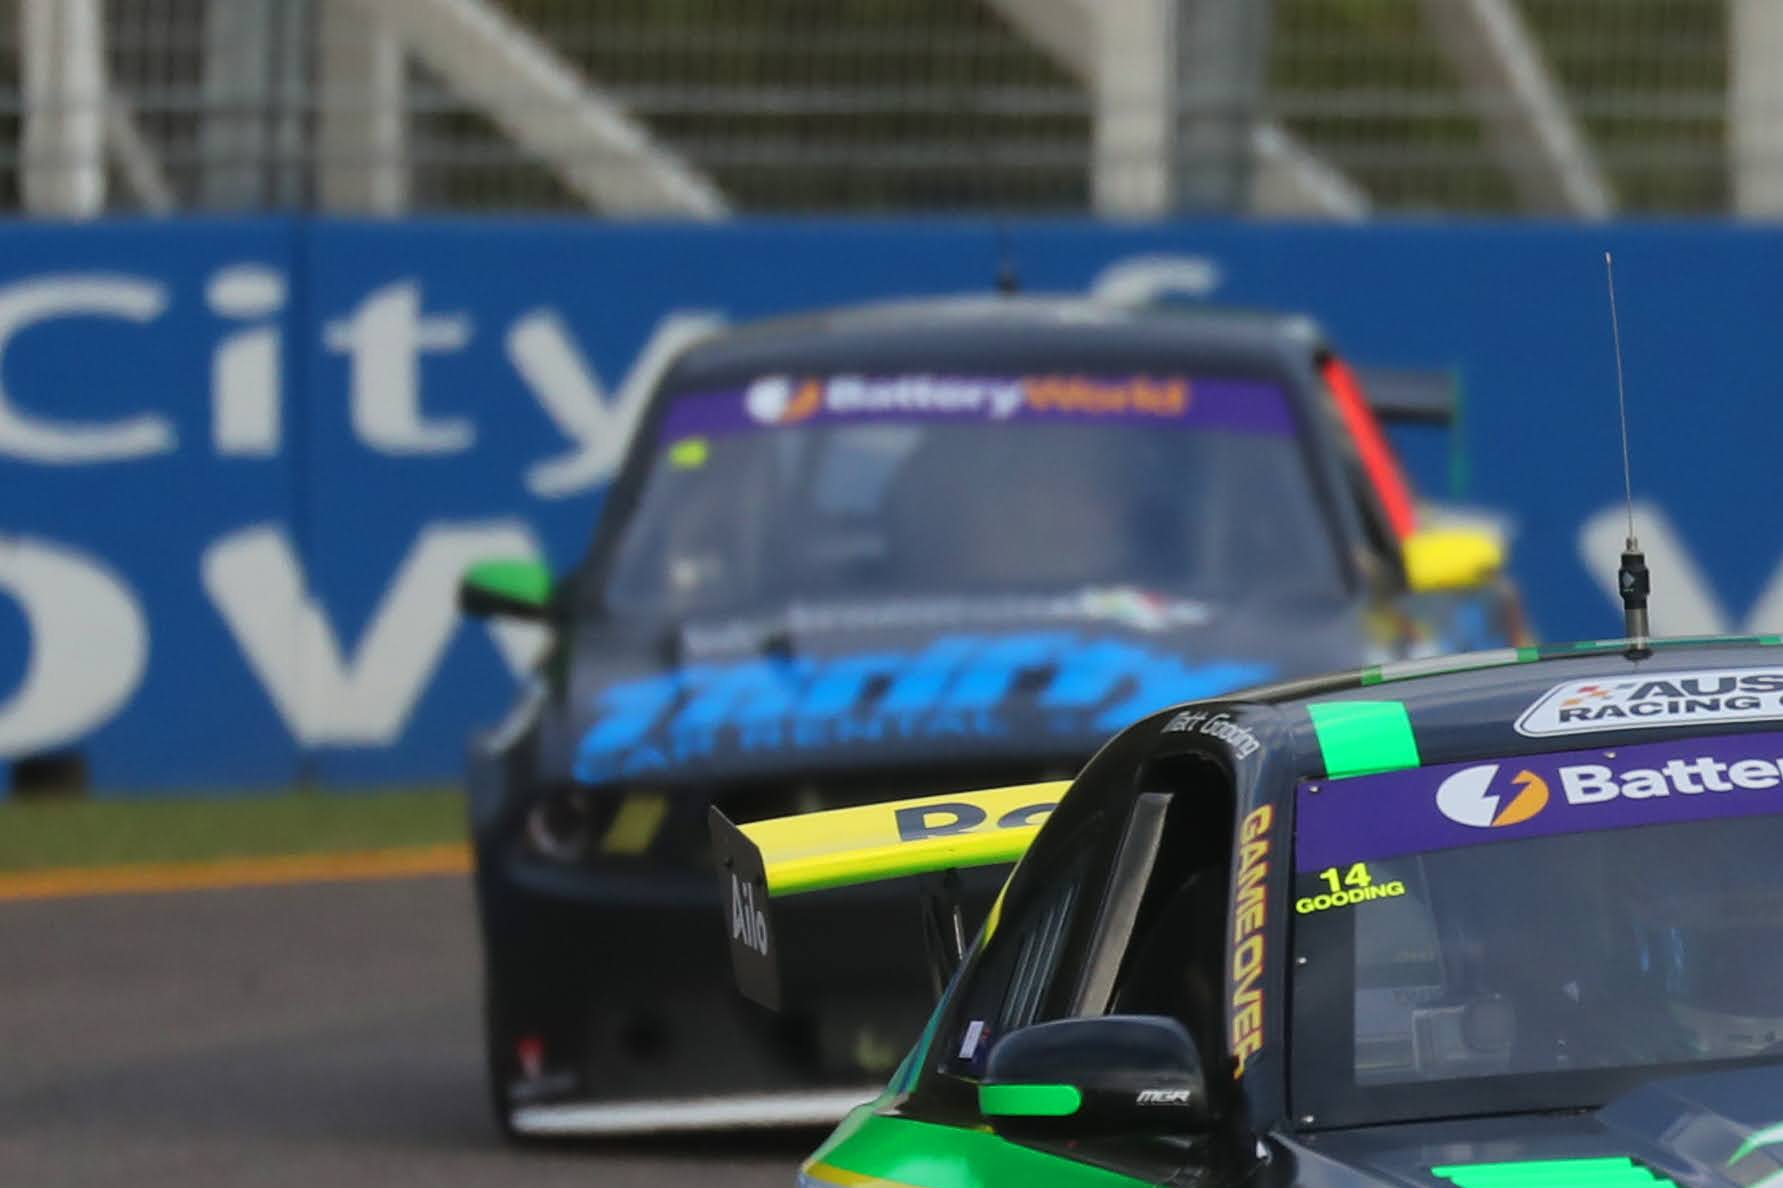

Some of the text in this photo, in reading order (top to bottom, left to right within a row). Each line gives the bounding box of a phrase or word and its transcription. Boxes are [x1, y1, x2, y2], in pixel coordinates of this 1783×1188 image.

[1558, 695, 1761, 724] RACING
[1319, 862, 1372, 893] 14
[1295, 880, 1406, 914] GOODING
